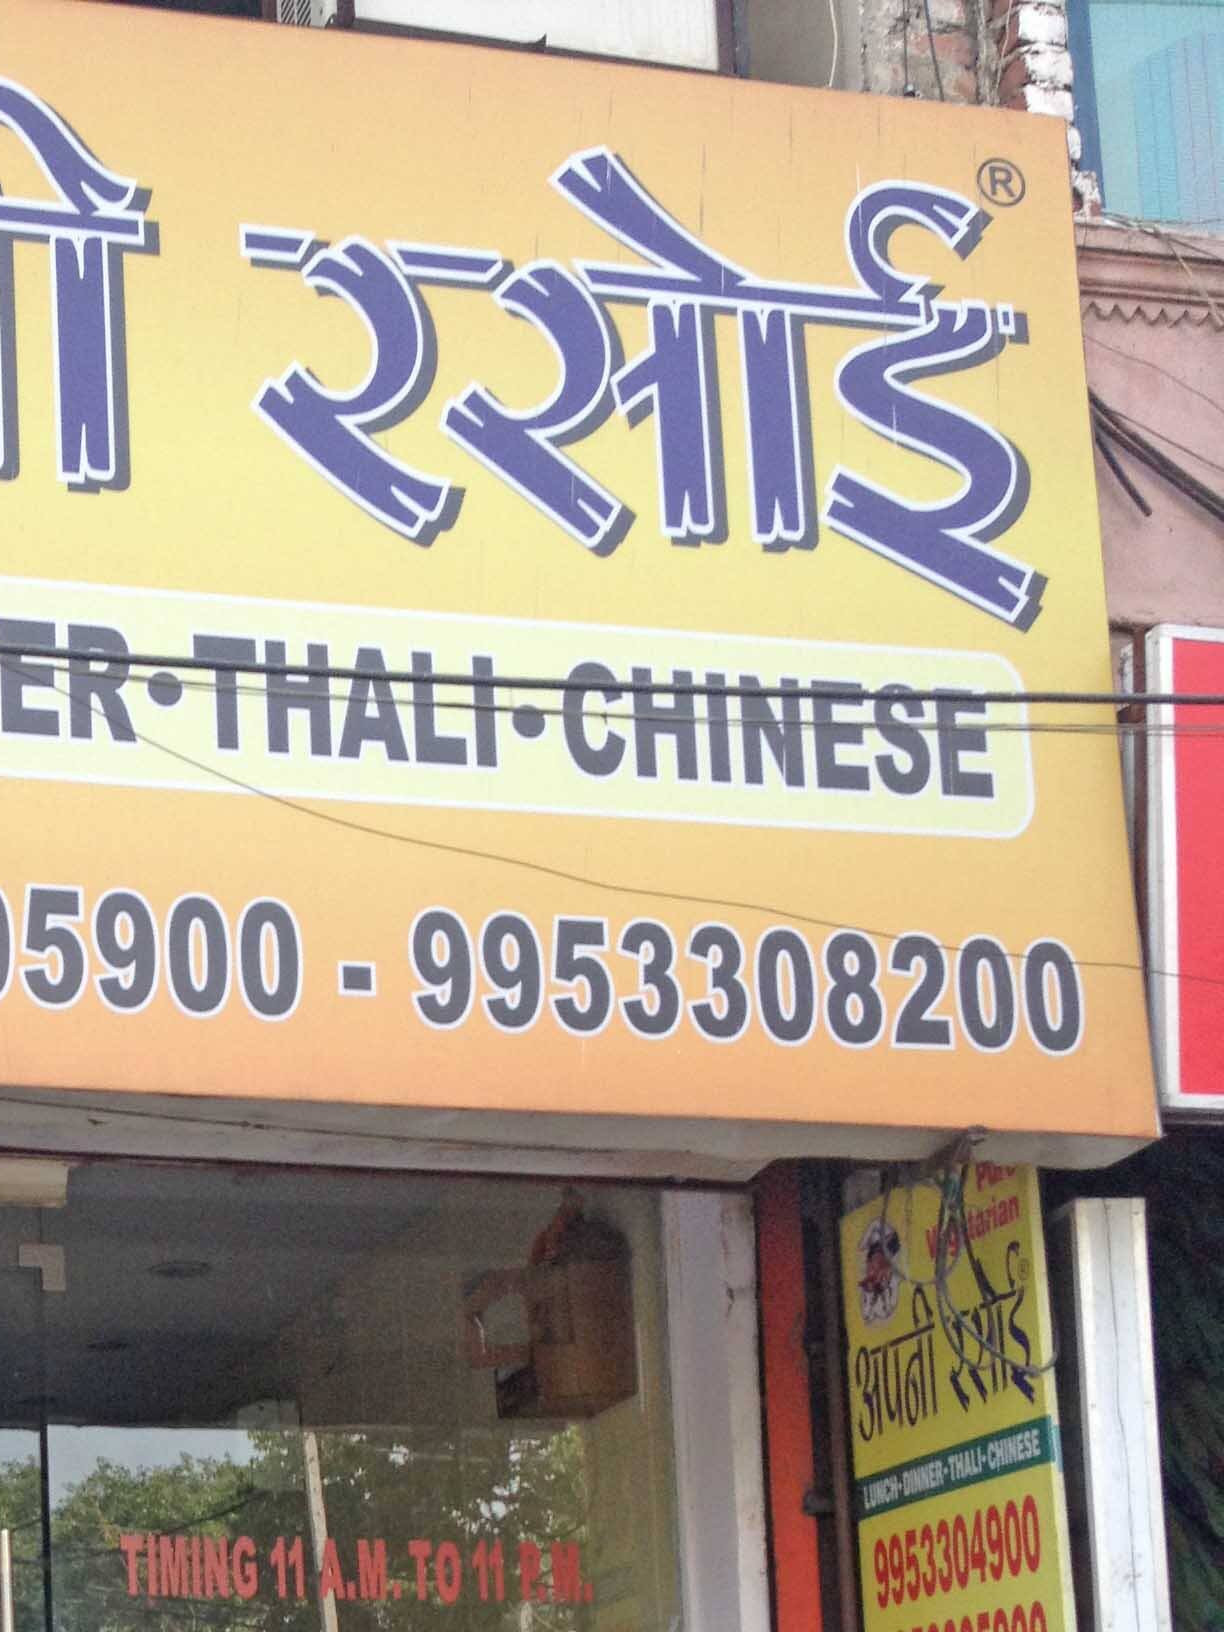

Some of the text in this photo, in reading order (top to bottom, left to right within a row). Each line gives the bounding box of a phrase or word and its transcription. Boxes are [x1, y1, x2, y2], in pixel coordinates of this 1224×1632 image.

[240, 146, 1047, 632] रसोई
[193, 635, 499, 766] THALI
[562, 662, 995, 798] CHINESE
[409, 907, 1084, 1056] 9953308200
[119, 1534, 258, 1599] TIMING
[270, 1535, 305, 1598] 11
[319, 1537, 403, 1601] A.M.
[408, 1539, 461, 1605] TO
[472, 1539, 505, 1601] 11
[874, 1494, 1041, 1608] 9953304900
